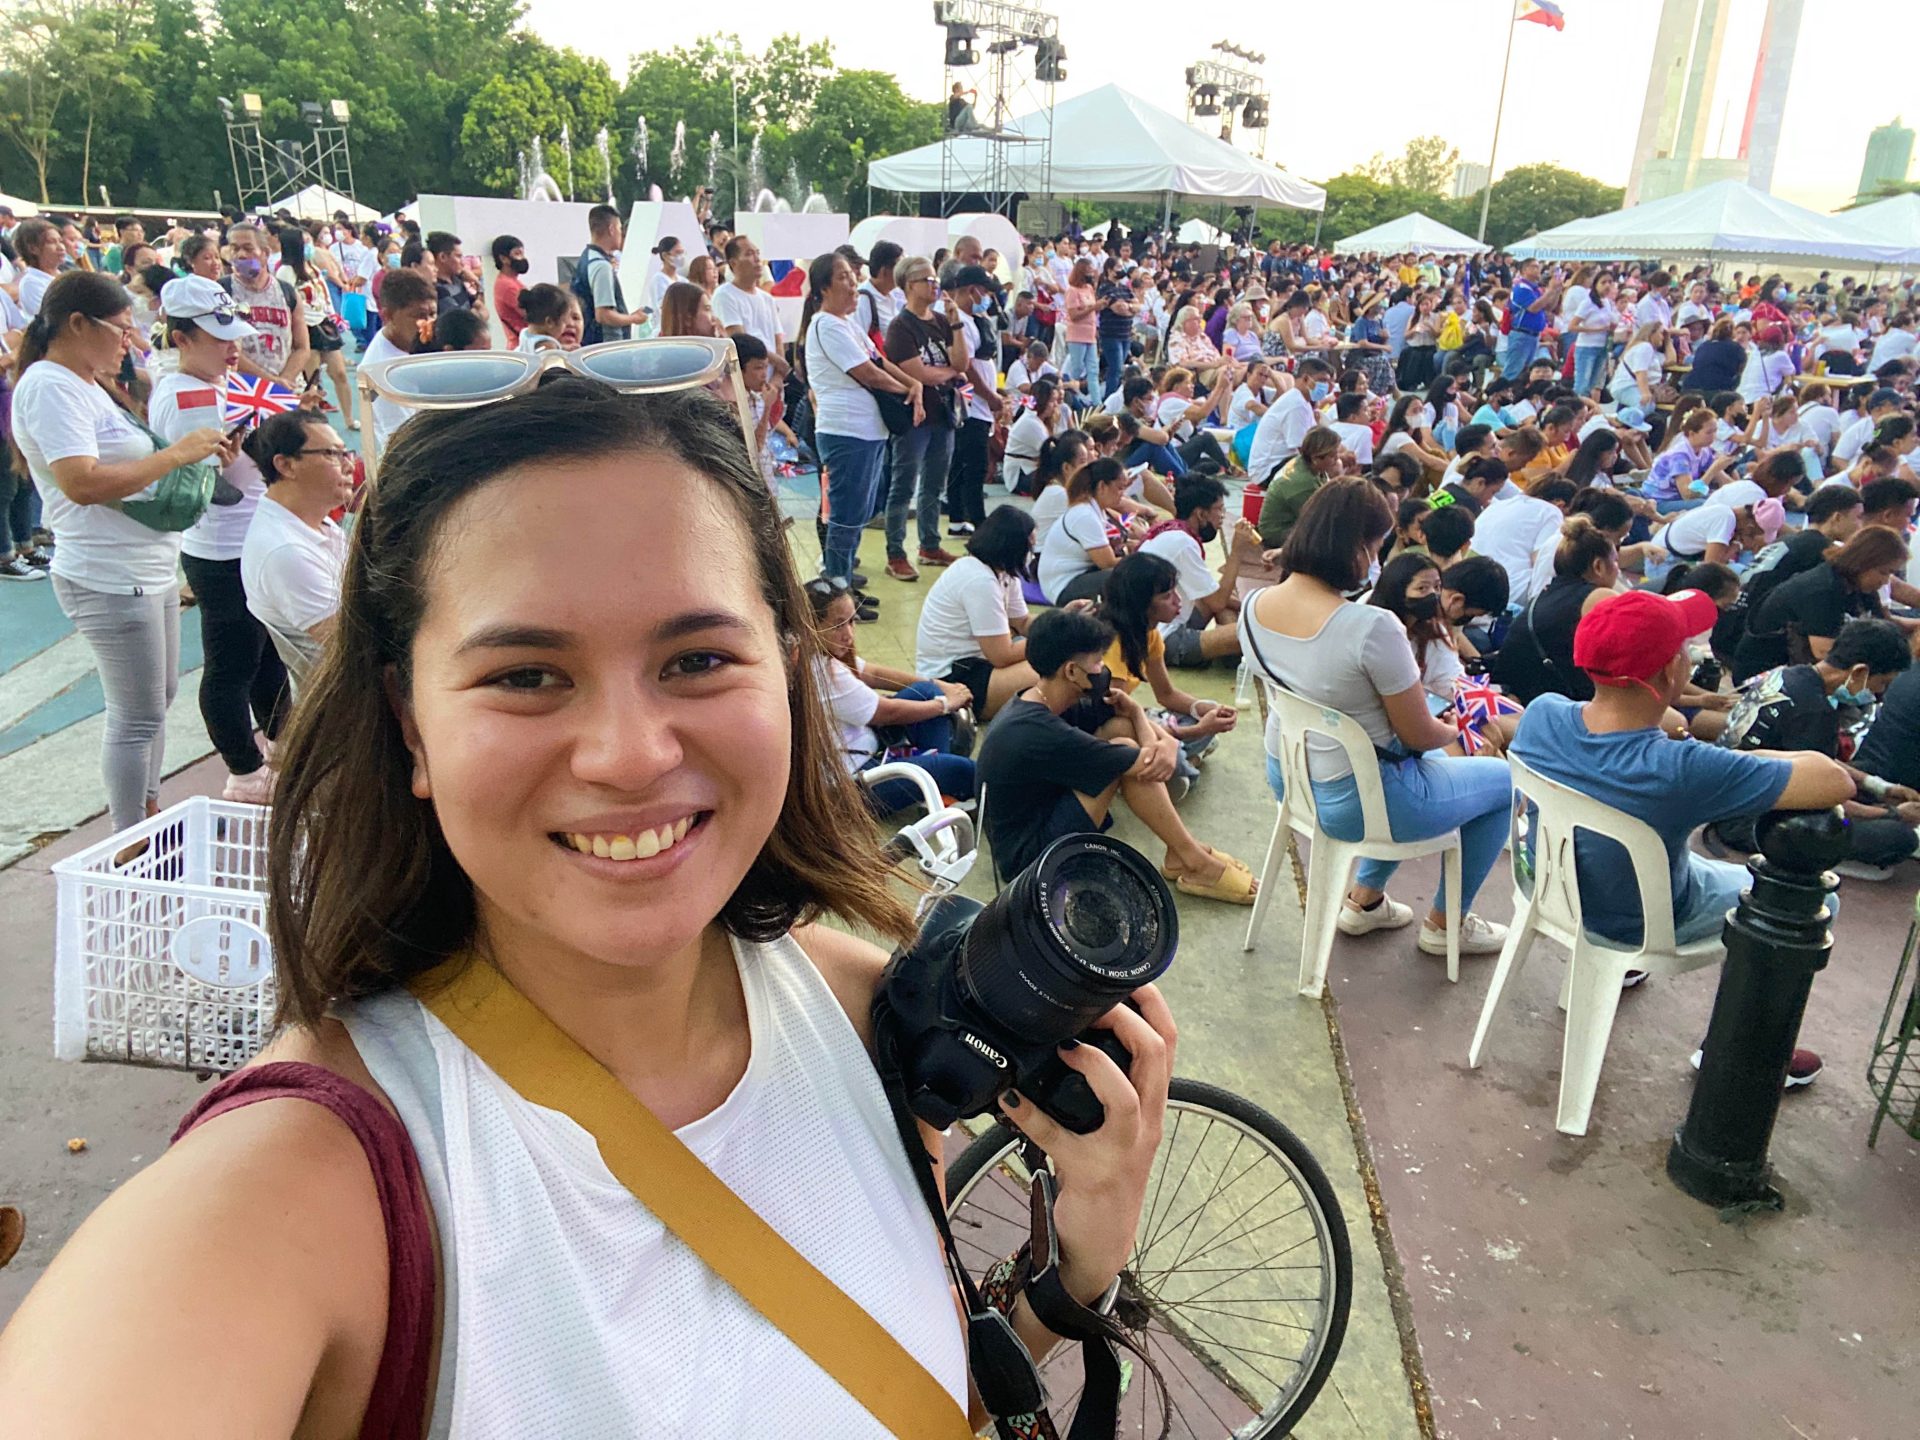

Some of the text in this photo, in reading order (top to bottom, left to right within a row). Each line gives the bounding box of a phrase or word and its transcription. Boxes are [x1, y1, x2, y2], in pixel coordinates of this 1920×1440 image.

[1084, 843, 1107, 852] CANON
[1089, 963, 1105, 975] LENS
[1108, 970, 1128, 978] ZOOM
[1131, 962, 1151, 975] CANON
[964, 1032, 1008, 1069] Canon
